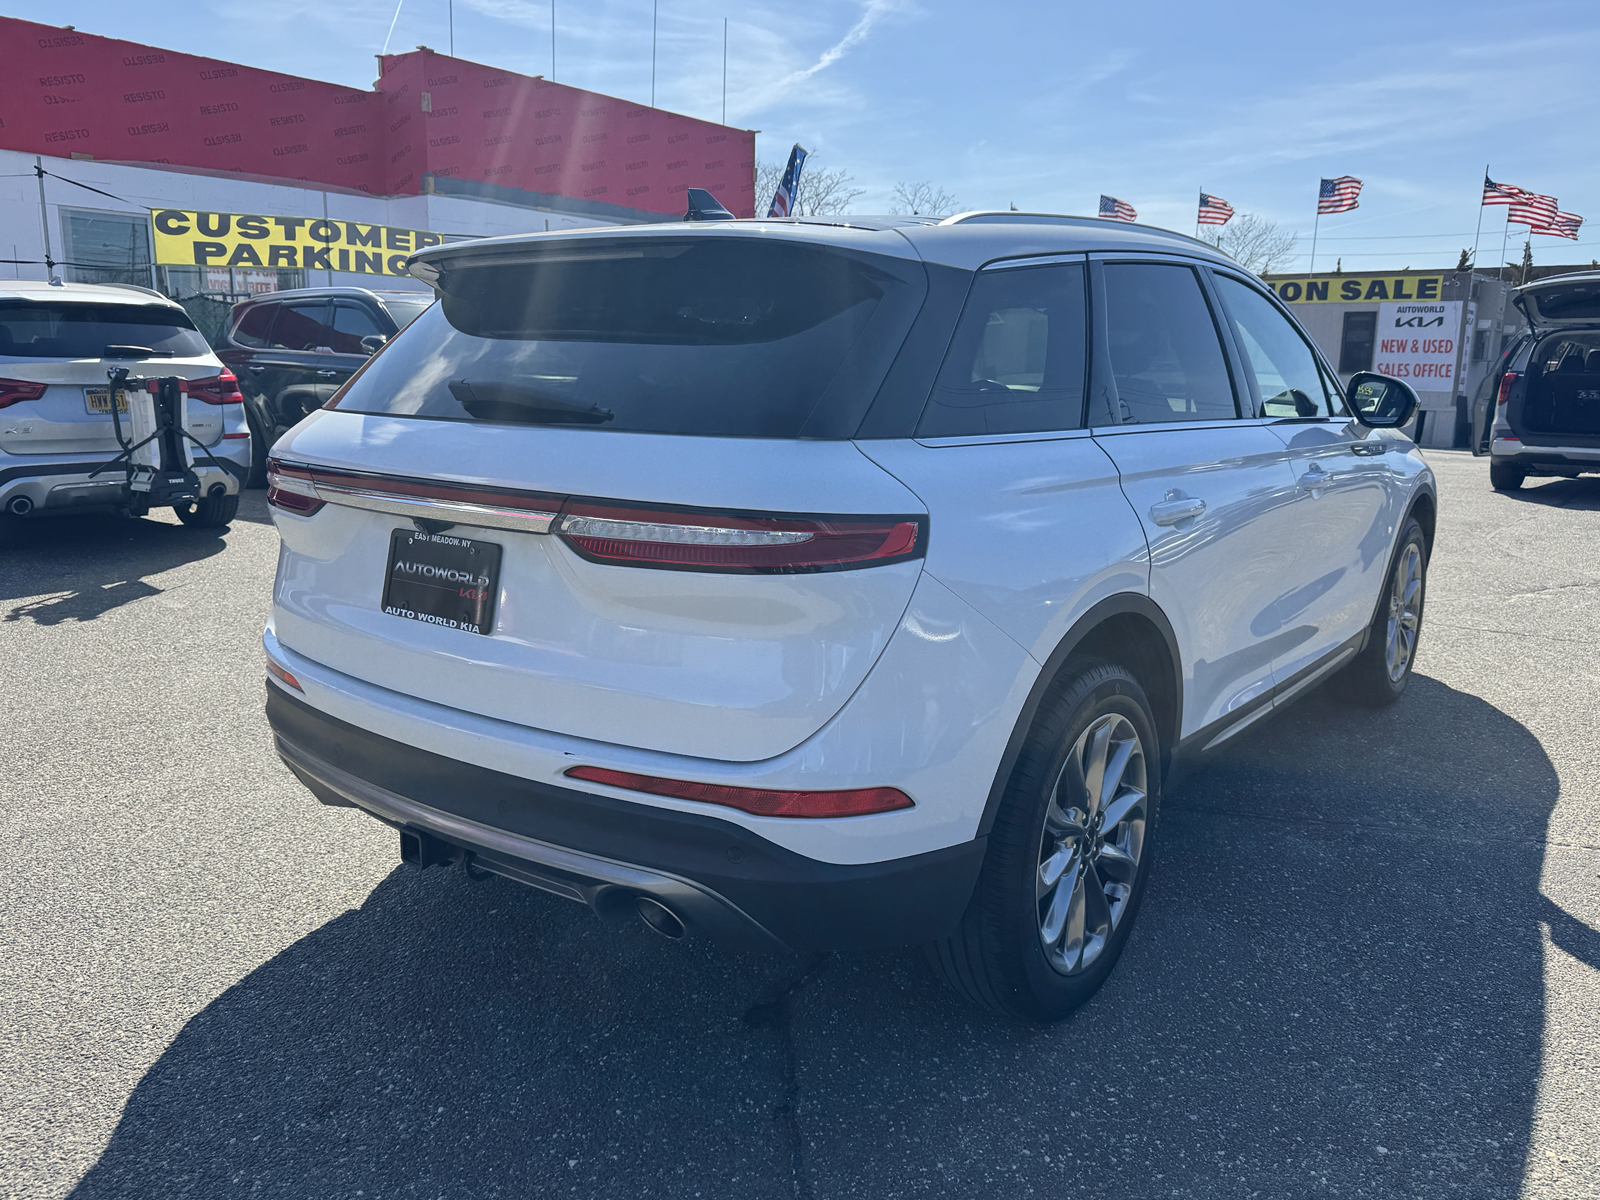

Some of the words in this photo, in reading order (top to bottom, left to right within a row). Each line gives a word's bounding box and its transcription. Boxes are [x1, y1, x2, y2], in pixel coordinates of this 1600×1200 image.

[38, 35, 85, 49] RESISTO
[123, 53, 165, 66] RESISTO
[39, 73, 85, 87] RESISTO
[200, 68, 238, 80] RESISTO
[270, 81, 305, 93] RESISTO
[427, 75, 459, 87] RESISTO
[123, 90, 165, 103] RESISTO
[334, 93, 366, 105] RESISTO
[200, 102, 239, 115] RESISTO
[427, 106, 458, 119] RESISTO
[482, 107, 511, 119] RESISTO
[534, 108, 561, 119] RESISTO
[270, 114, 305, 126] RESISTO
[44, 128, 90, 143] RESISTO
[128, 122, 170, 136] RESISTO
[333, 124, 366, 137] RESISTO
[204, 133, 242, 147] RESISTO
[430, 135, 460, 147] RESISTO
[273, 143, 308, 157] RESISTO
[336, 153, 369, 166] RESISTO
[484, 165, 512, 177] RESISTO
[534, 163, 561, 175] RESISTO
[581, 161, 606, 172] RESISTO
[1340, 279, 1439, 301] SALE
[1396, 305, 1445, 314] AUTOWORLD
[1381, 339, 1409, 354] NEW
[1410, 339, 1419, 354] &
[1422, 339, 1453, 354] USED
[1377, 363, 1411, 378] SALES
[1413, 363, 1453, 378] OFFICE
[414, 532, 430, 542] EAST
[461, 539, 471, 548] NY
[394, 560, 489, 587] AUTOWORLD
[385, 606, 415, 619] AUTO
[417, 612, 457, 628] WORLD
[460, 621, 480, 634] KIA
